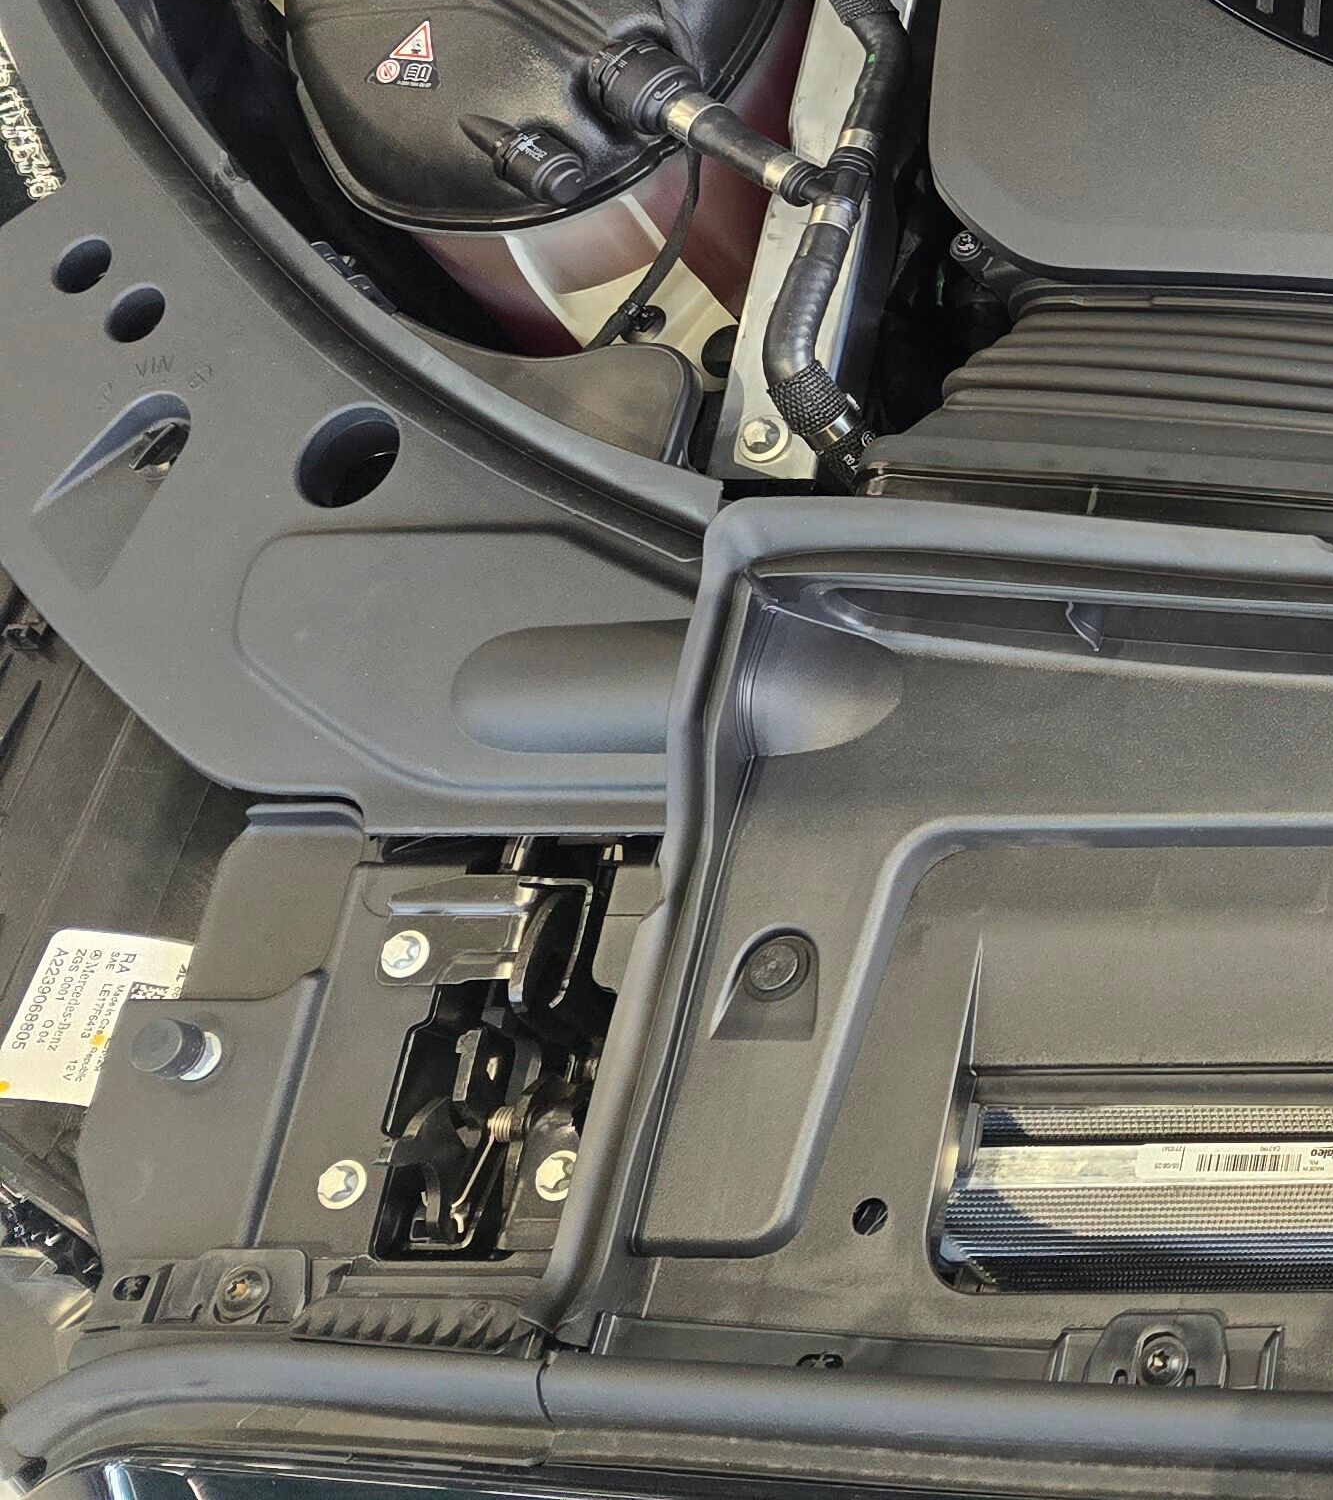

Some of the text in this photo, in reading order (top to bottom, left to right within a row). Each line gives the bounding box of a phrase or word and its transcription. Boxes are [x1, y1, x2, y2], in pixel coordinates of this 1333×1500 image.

[135, 353, 175, 378] VIN
[67, 948, 88, 973] ZGS
[105, 951, 121, 970] SAE
[115, 952, 138, 974] RA
[11, 946, 69, 1050] A2239068805
[54, 975, 74, 1001] 0001
[108, 984, 126, 1009] Made
[47, 960, 99, 1052] Mercedes-Benz
